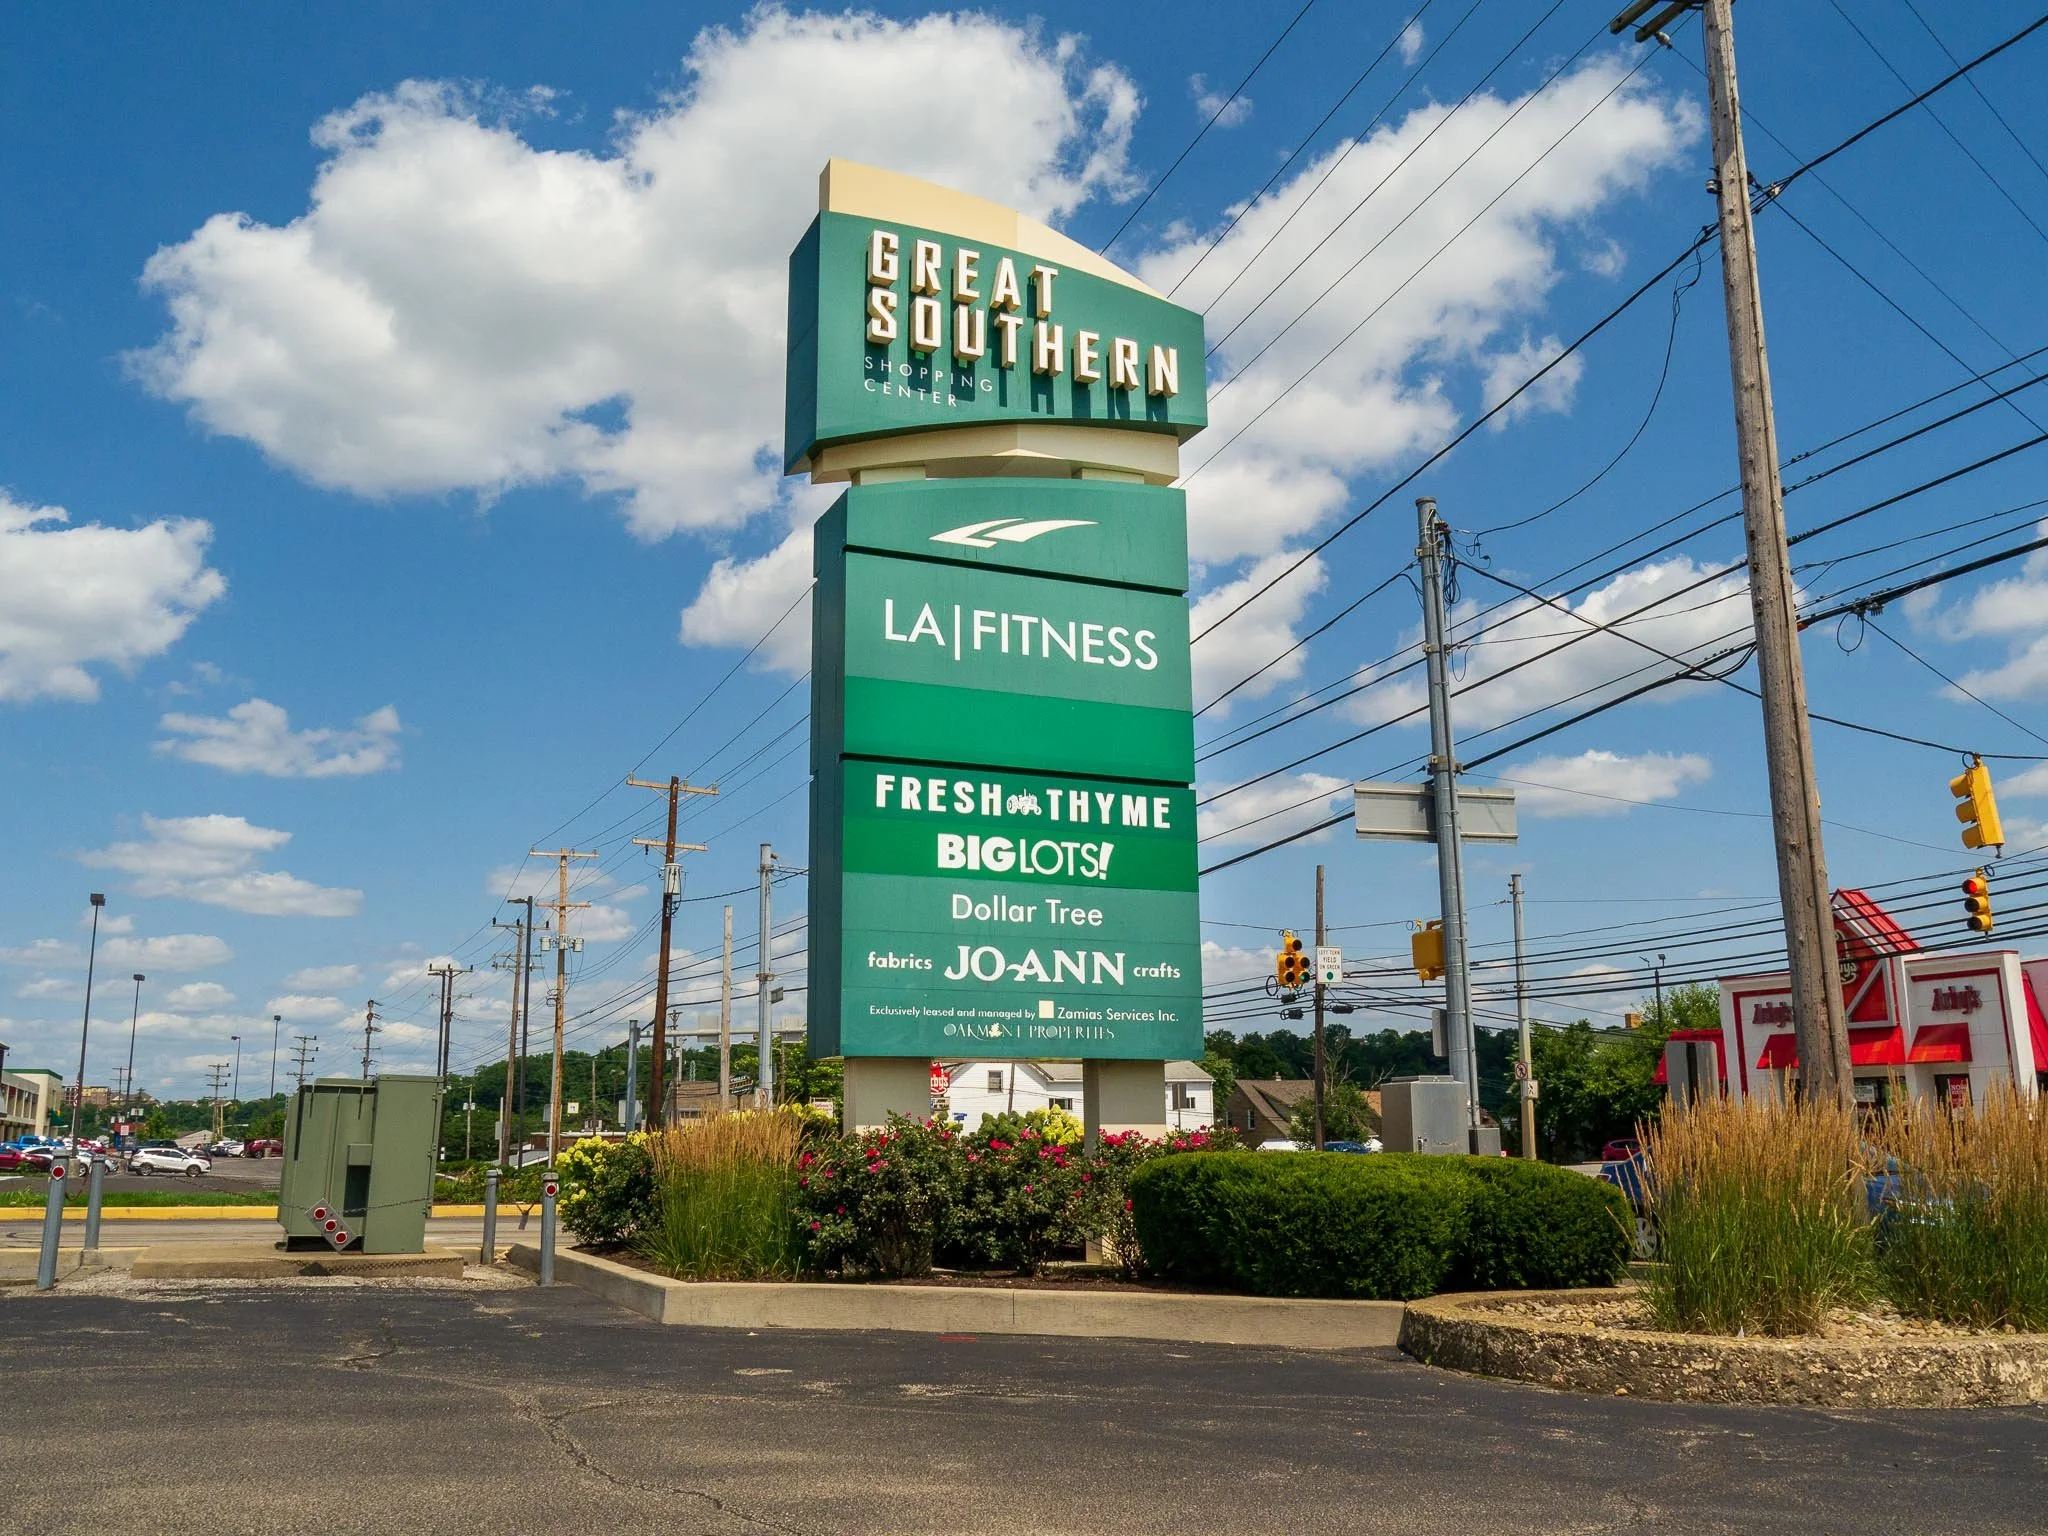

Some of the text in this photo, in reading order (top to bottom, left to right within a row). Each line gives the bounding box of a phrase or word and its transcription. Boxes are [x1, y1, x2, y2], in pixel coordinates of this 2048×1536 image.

[868, 230, 1058, 319] GREAT
[867, 286, 1179, 399] SOUTHERN
[864, 356, 993, 393] SHOPPING
[864, 378, 957, 407] CENTER
[876, 774, 1171, 829] FRESH THYME
[952, 893, 1103, 927] Dollar Tree
[868, 951, 933, 971] fabrics
[1133, 962, 1181, 979] crafts
[869, 1005, 1179, 1022] Exclusively leased and managed by Zamias Services Inc.
[943, 1022, 1021, 1041] OAKMNT
